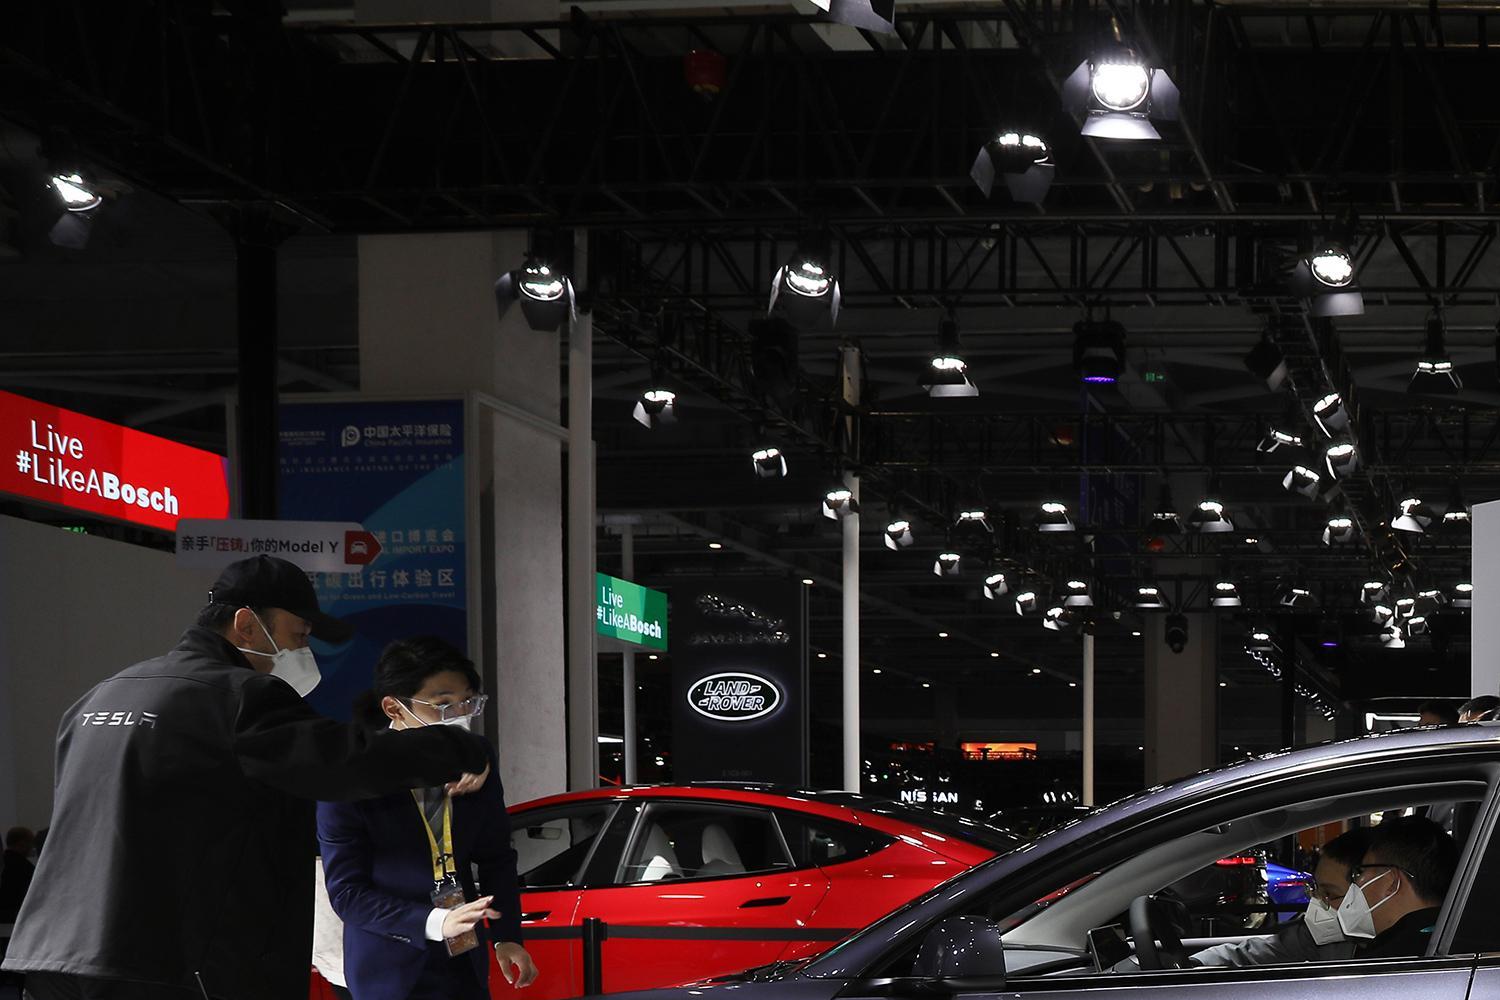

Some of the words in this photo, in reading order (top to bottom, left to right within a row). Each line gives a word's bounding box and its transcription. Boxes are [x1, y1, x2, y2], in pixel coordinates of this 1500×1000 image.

[31, 419, 84, 459] Live
[363, 424, 452, 439] 中国太平洋保险
[16, 449, 179, 516] #LikeABosch
[328, 541, 339, 553] Y
[429, 544, 455, 553] EXPO
[602, 586, 623, 608] Live
[596, 605, 662, 639] #LikeABosch
[82, 711, 159, 729] TESLA
